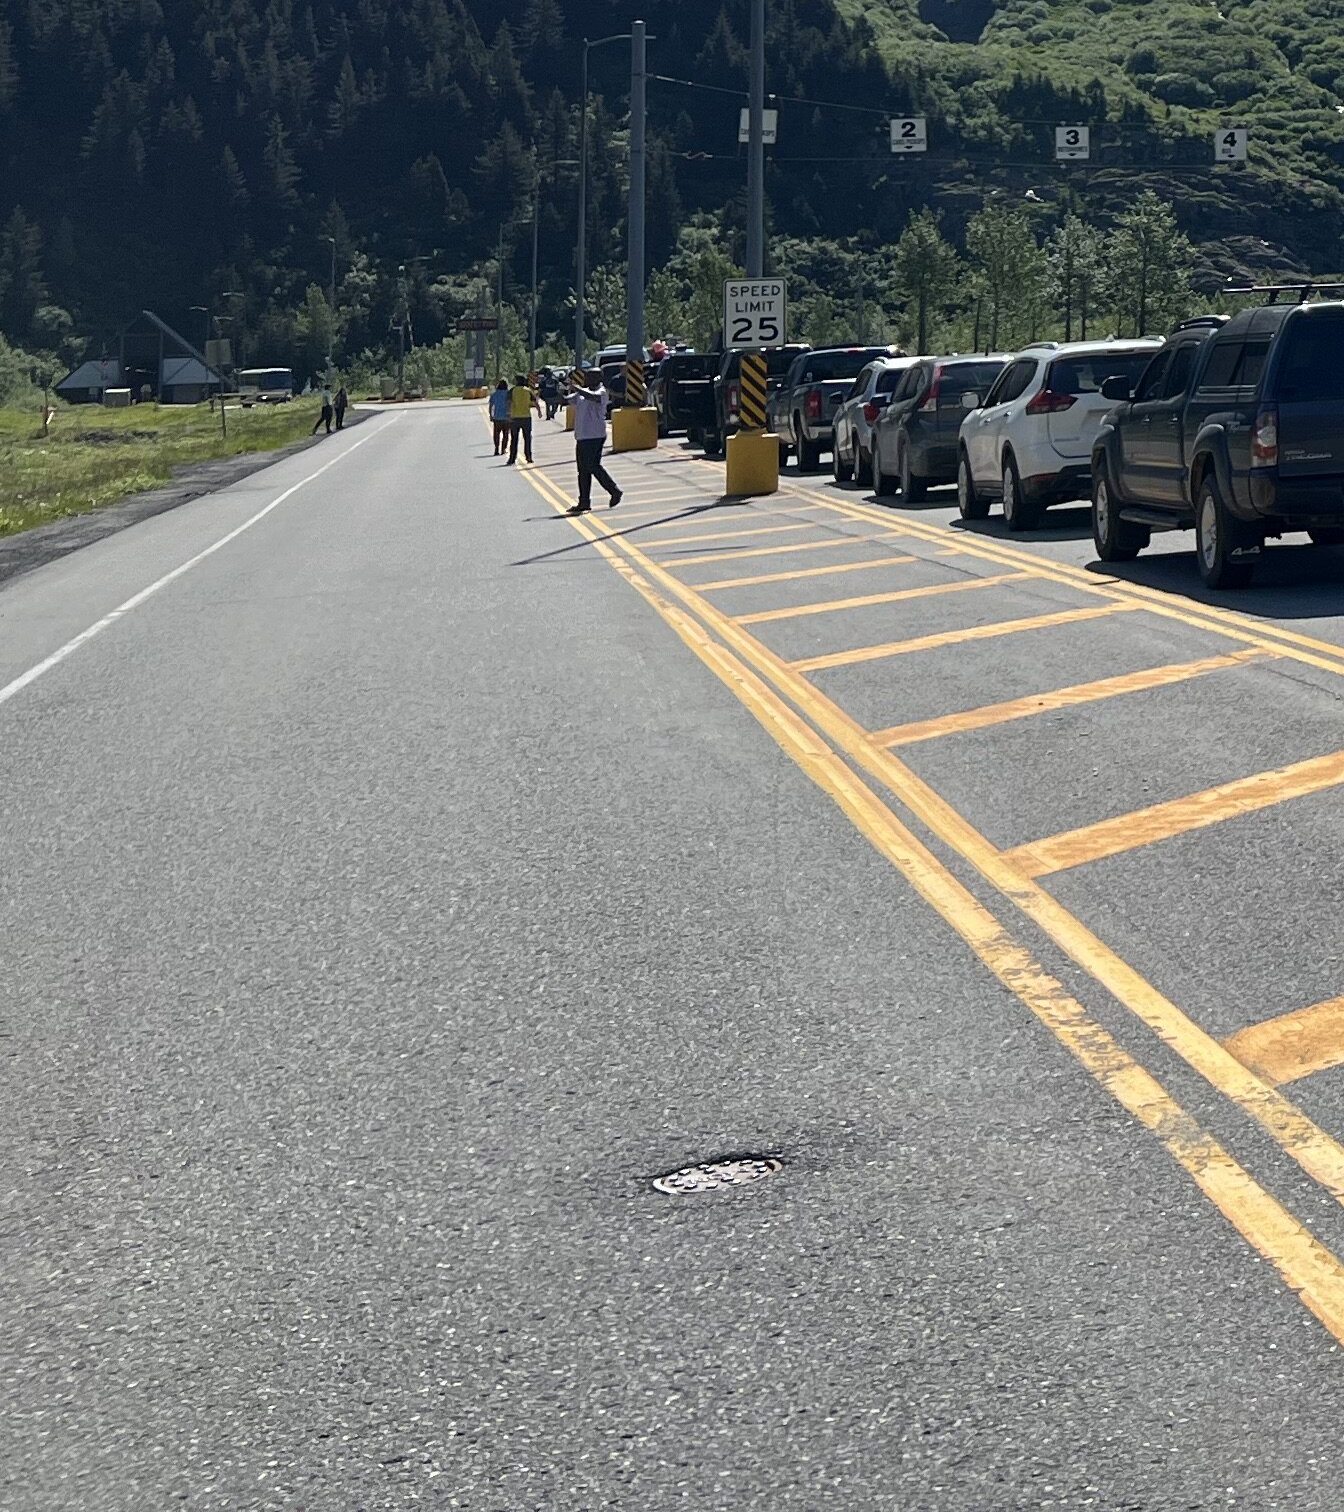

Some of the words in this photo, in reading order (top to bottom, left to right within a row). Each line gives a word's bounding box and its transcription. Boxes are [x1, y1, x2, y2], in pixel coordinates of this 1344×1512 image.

[901, 121, 917, 138] 2
[1065, 129, 1080, 146] 3
[1222, 131, 1238, 147] 4
[729, 284, 781, 298] SPEED
[735, 300, 775, 313] LIMIT
[731, 316, 779, 343] 25
